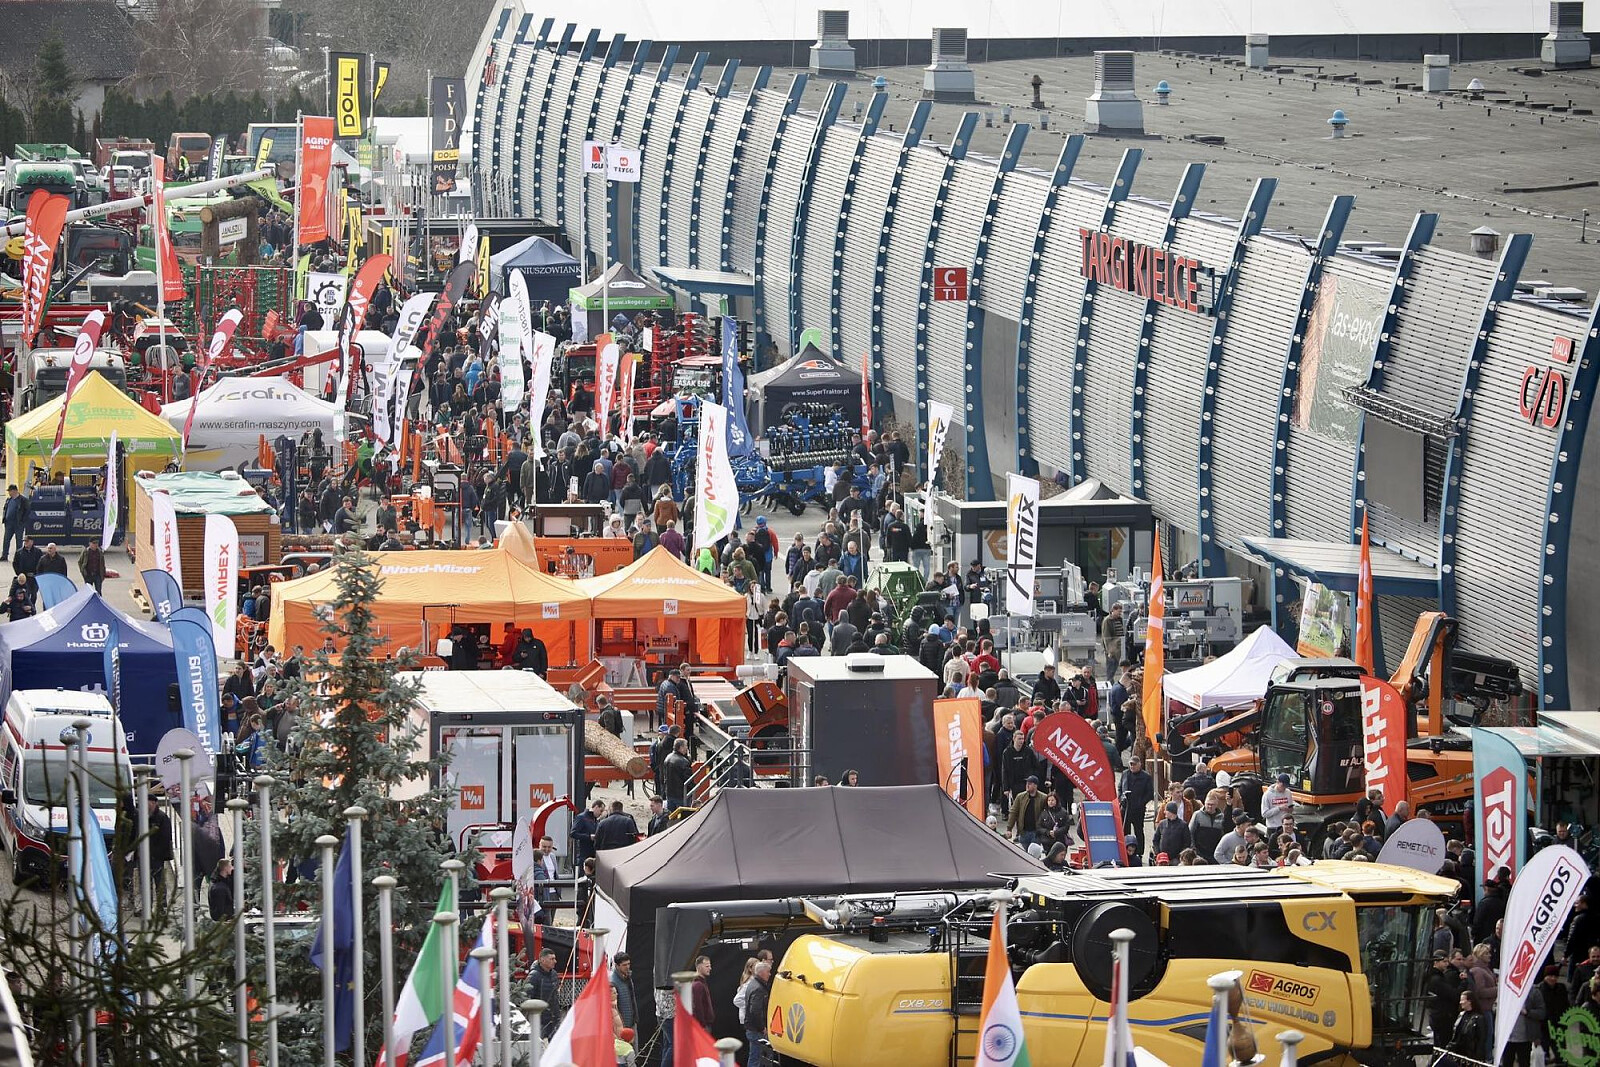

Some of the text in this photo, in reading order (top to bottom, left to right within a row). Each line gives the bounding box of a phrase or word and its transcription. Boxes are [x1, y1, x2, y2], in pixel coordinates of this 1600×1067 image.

[342, 67, 355, 128] DOLL
[304, 136, 330, 145] AGRO
[211, 137, 223, 180] NUSZKI
[437, 151, 458, 159] DOLL
[507, 266, 582, 275] KNIUSZOWIANK
[944, 271, 957, 286] C
[1079, 228, 1200, 313] TARGI KIELCE
[943, 288, 957, 300] T1
[792, 388, 850, 396] www.SuperTraktor.pl
[1519, 365, 1566, 428] C/D
[199, 420, 321, 431] www.serafin-maszyny.com
[704, 415, 716, 500] WIREX
[1007, 493, 1035, 600] Amix
[381, 563, 481, 575] Wood-Mizer
[632, 577, 699, 585] Wood-Mizer
[1048, 727, 1096, 770] NEW
[1044, 747, 1060, 763] FROM
[1059, 760, 1077, 777] REMET
[463, 790, 482, 806] WM
[532, 788, 551, 803] WM
[1530, 864, 1572, 942] AGROS
[1303, 911, 1338, 932] CX
[1273, 978, 1317, 1000] AGROS
[1268, 1000, 1320, 1024] HOLLAND
